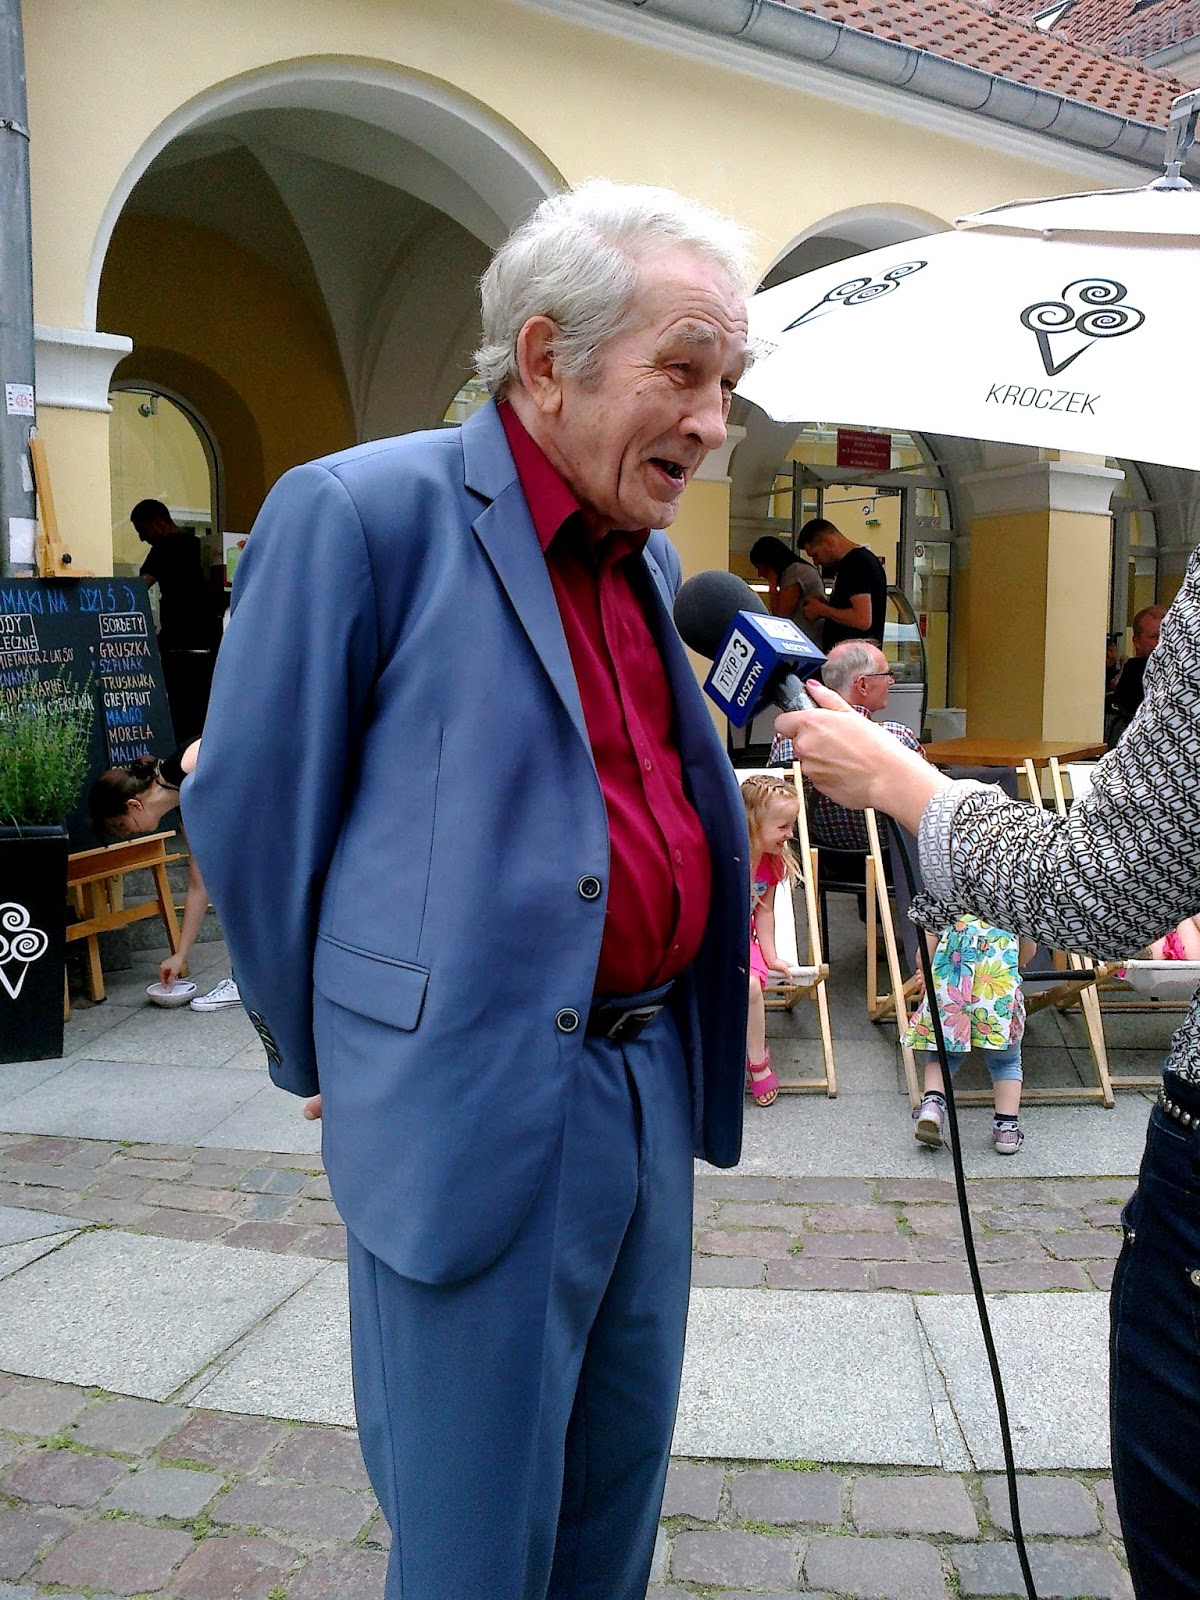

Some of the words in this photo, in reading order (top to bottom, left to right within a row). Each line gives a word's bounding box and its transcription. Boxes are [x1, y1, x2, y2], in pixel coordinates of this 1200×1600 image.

[985, 383, 1101, 415] KROCZEK
[0, 588, 43, 615] MAKI
[47, 589, 68, 614] NA
[102, 617, 143, 633] SORBETY
[100, 641, 151, 658] GRUSZKA
[99, 657, 144, 673] SZPINAK
[101, 673, 156, 690] TRUSKAWKA
[737, 661, 764, 707] OLSZTYN
[106, 707, 143, 727] MANGO
[108, 723, 154, 744] MORELA
[110, 743, 149, 763] MALINA
